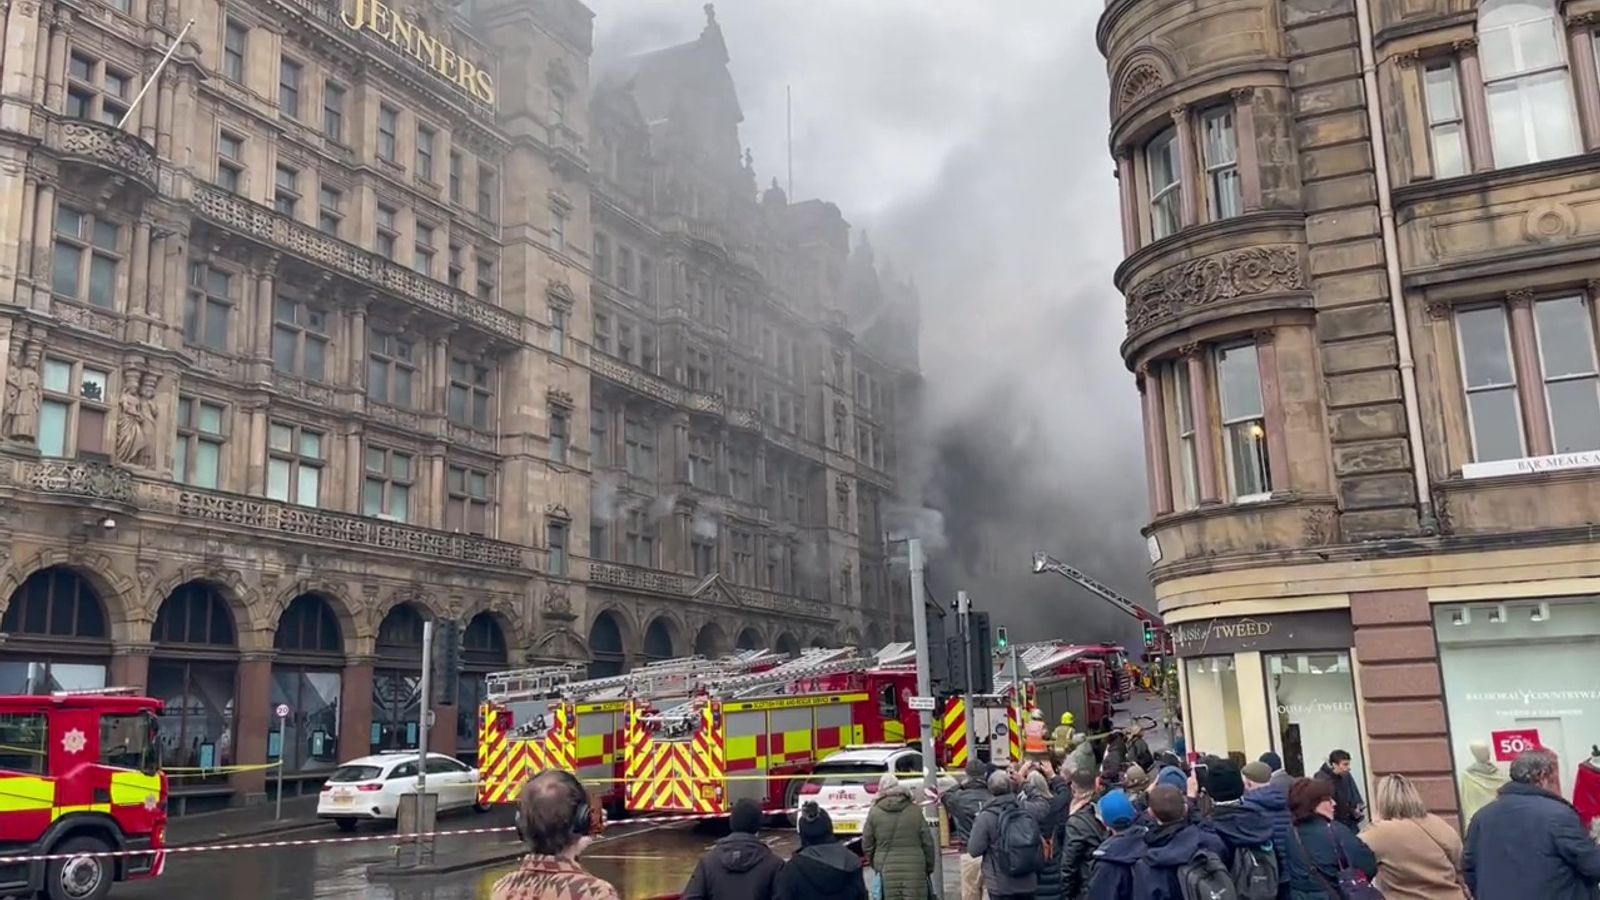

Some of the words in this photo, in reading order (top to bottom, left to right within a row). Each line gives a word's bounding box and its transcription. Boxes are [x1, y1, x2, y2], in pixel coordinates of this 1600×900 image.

[341, 0, 495, 104] JENNERS
[1518, 460, 1542, 471] BAR
[1546, 456, 1589, 467] MEALS
[1213, 622, 1271, 639] TWEED
[1318, 702, 1353, 713] TWEED
[828, 793, 857, 801] FIRE
